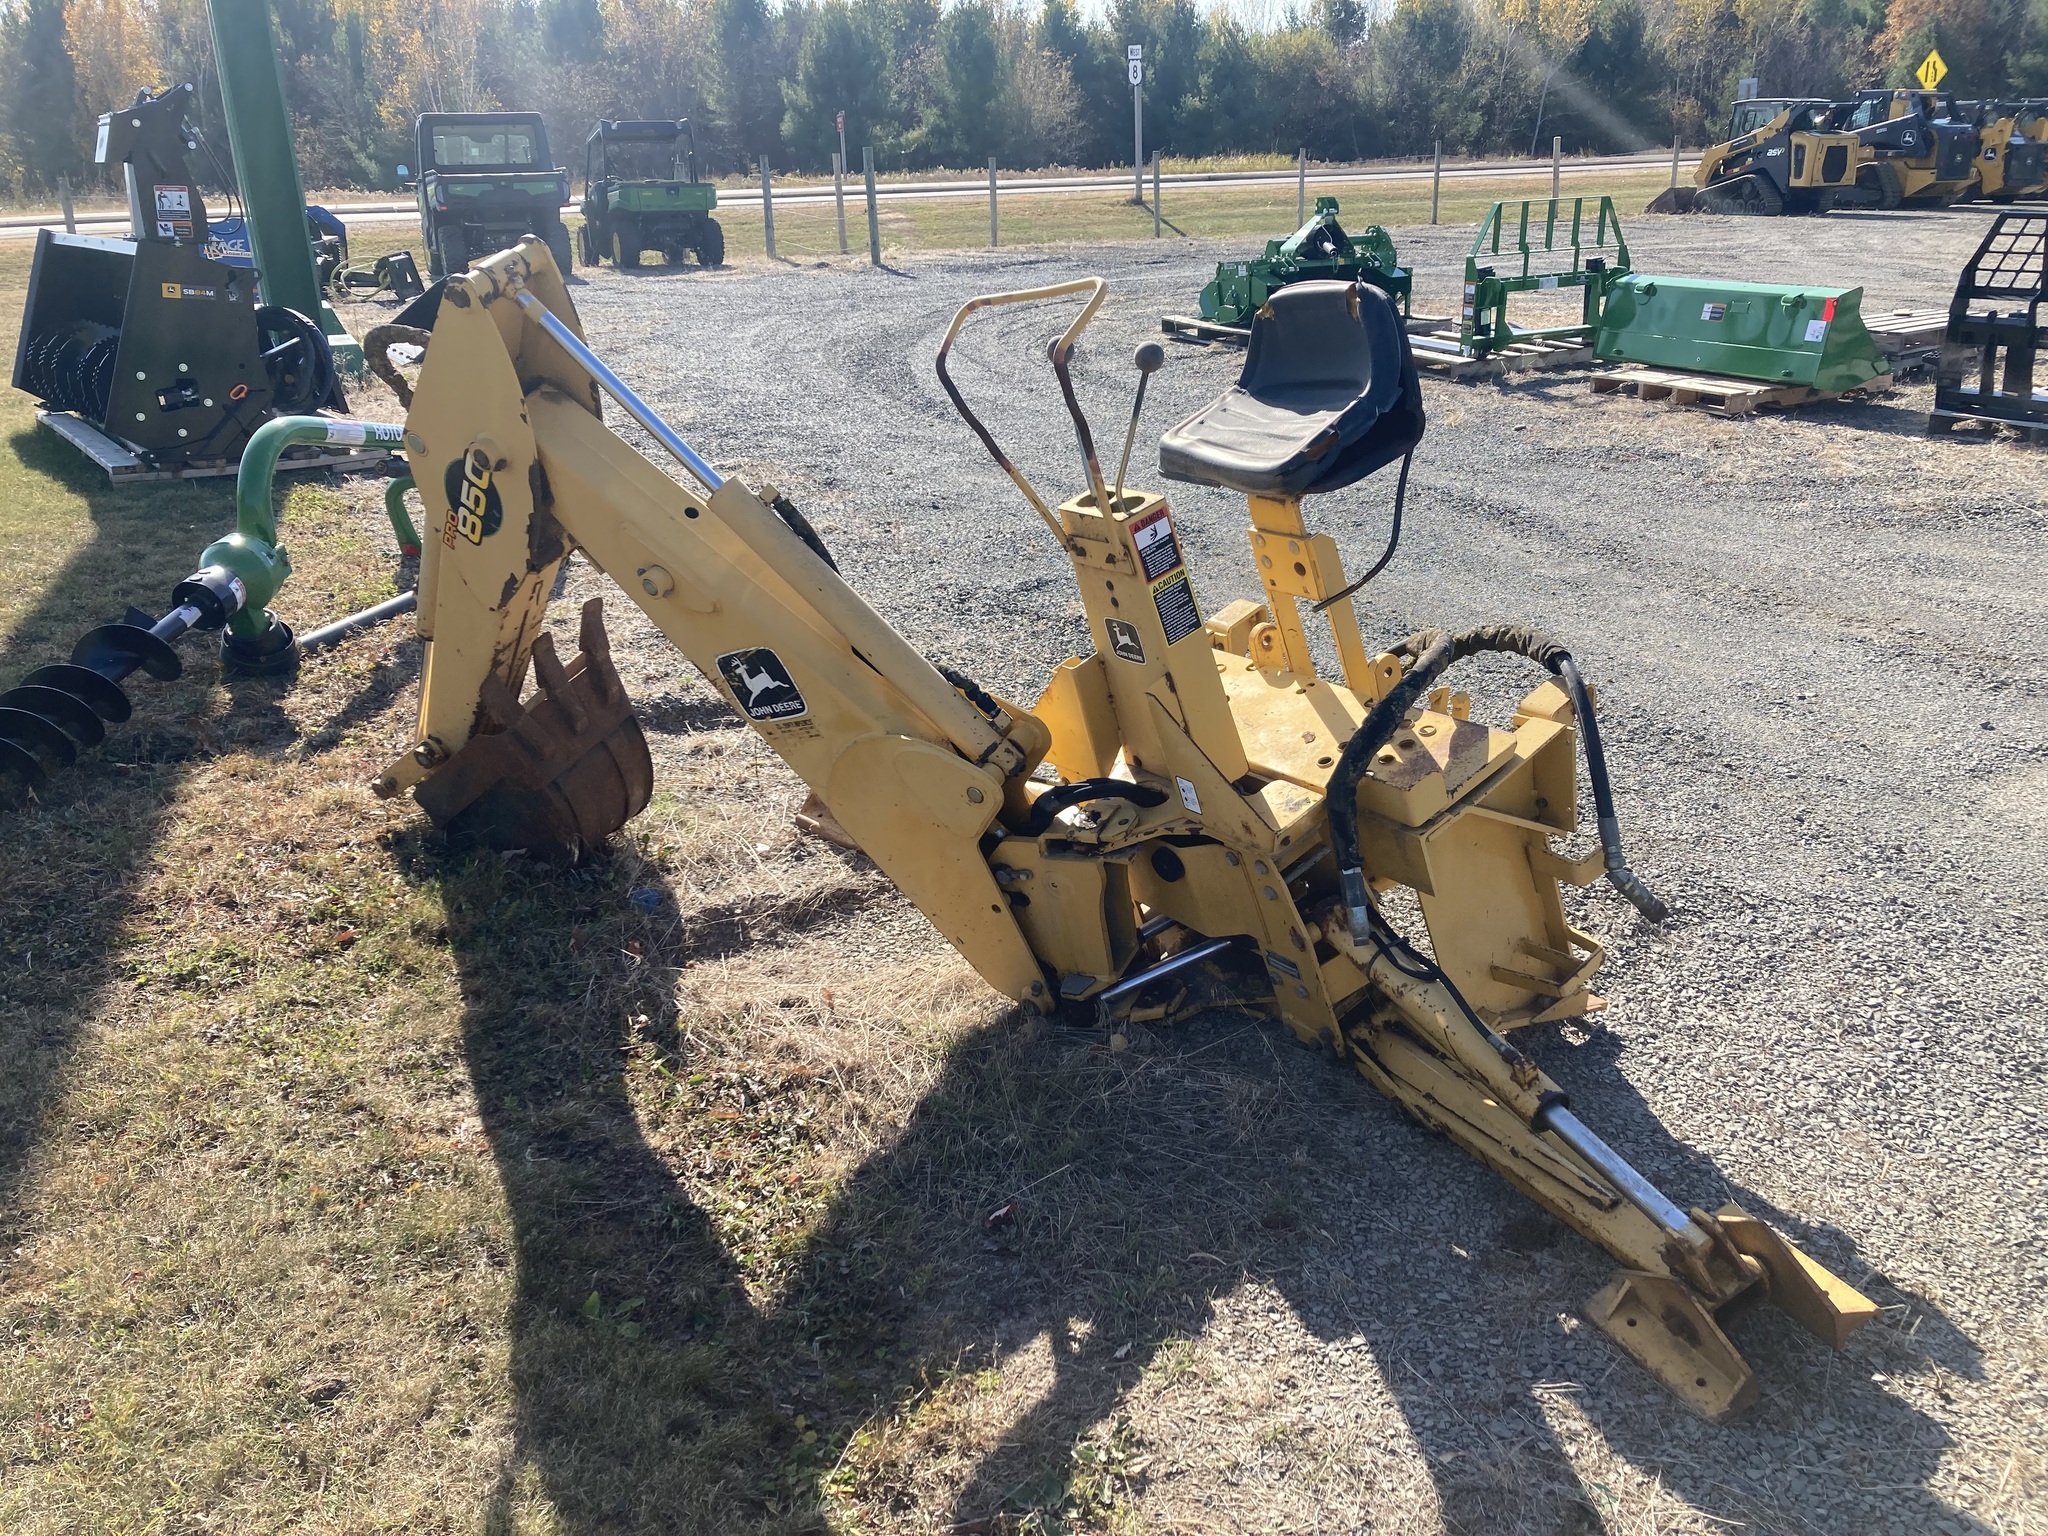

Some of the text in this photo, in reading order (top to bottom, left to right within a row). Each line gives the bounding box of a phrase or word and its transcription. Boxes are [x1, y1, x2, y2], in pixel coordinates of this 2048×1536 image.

[1132, 64, 1138, 80] 8
[1140, 509, 1165, 528] DANGER
[443, 508, 459, 550] PRO
[1157, 568, 1186, 590] CAUTION
[749, 700, 803, 717] JOHN DEERE
